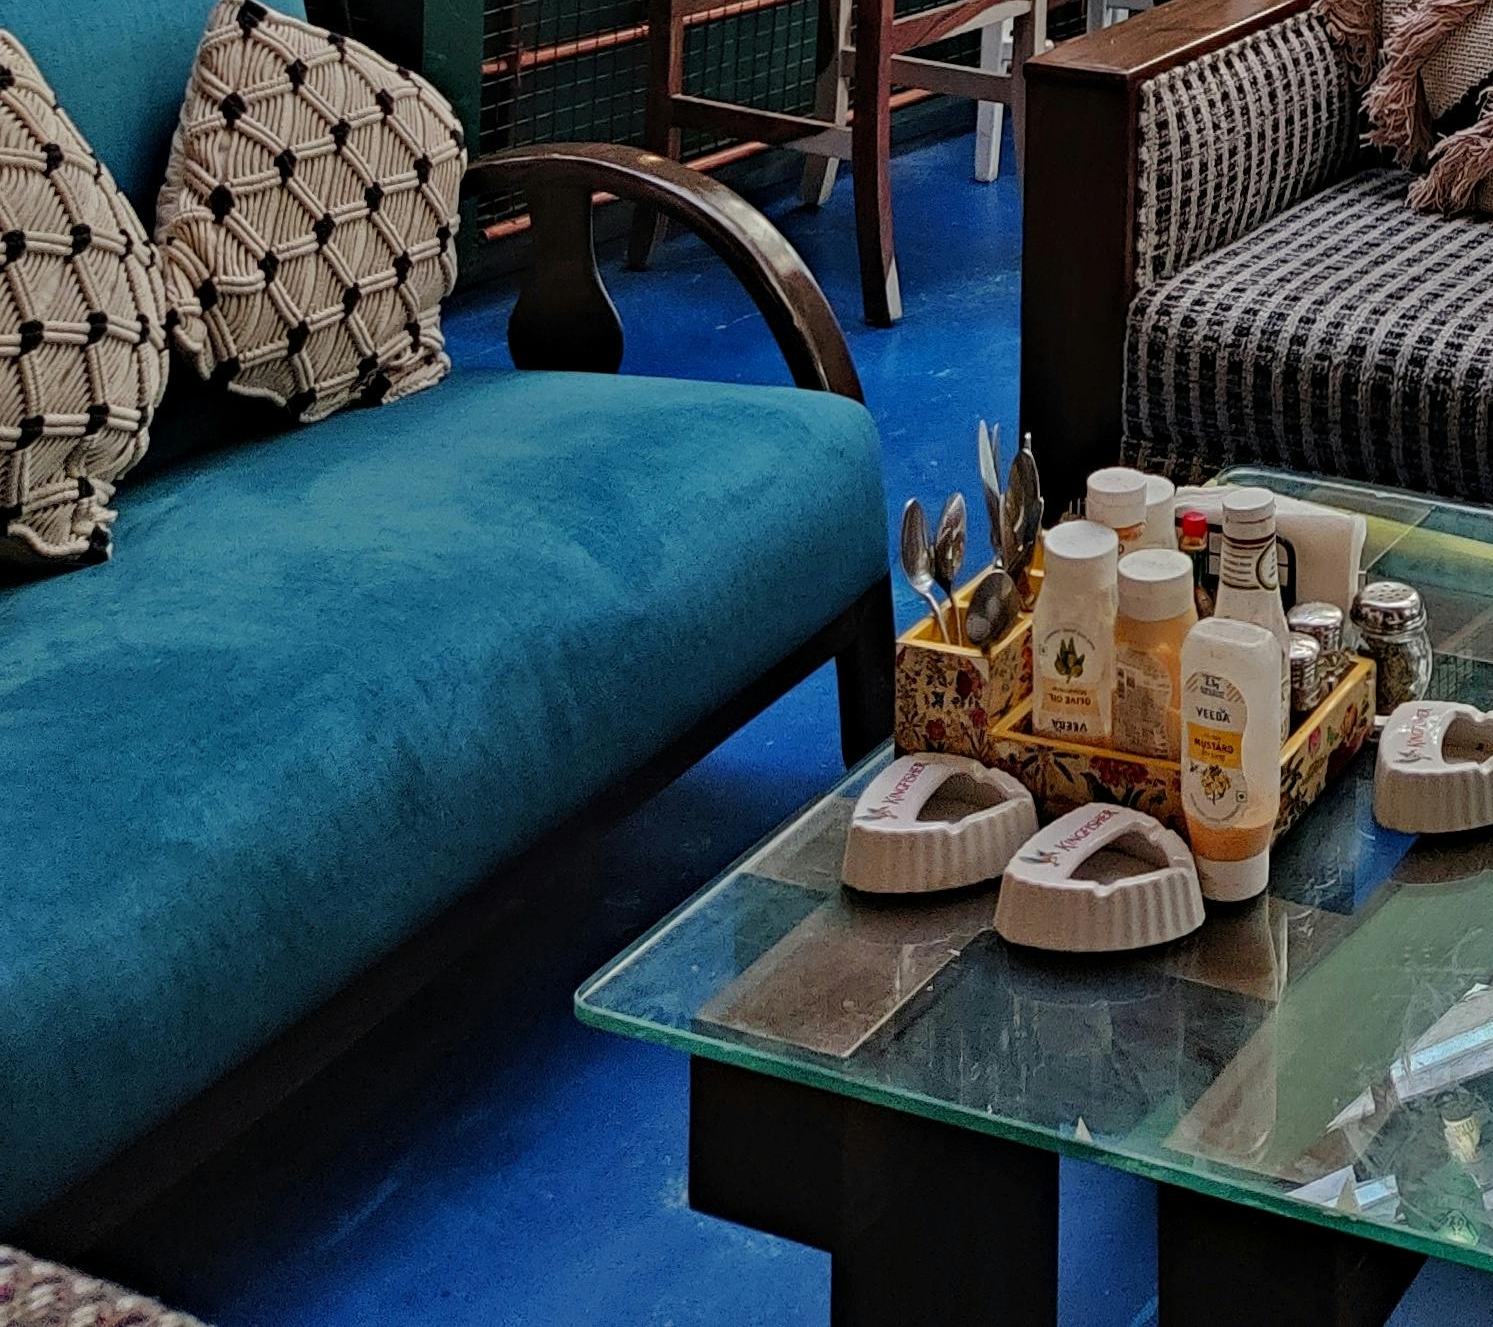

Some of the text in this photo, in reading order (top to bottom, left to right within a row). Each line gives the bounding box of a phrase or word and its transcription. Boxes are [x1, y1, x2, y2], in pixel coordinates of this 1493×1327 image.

[1064, 696, 1092, 707] OLIVE
[1194, 736, 1235, 755] MUSTARD
[882, 761, 929, 805] KINGFISHER
[1055, 808, 1119, 853] KINGFISHER
